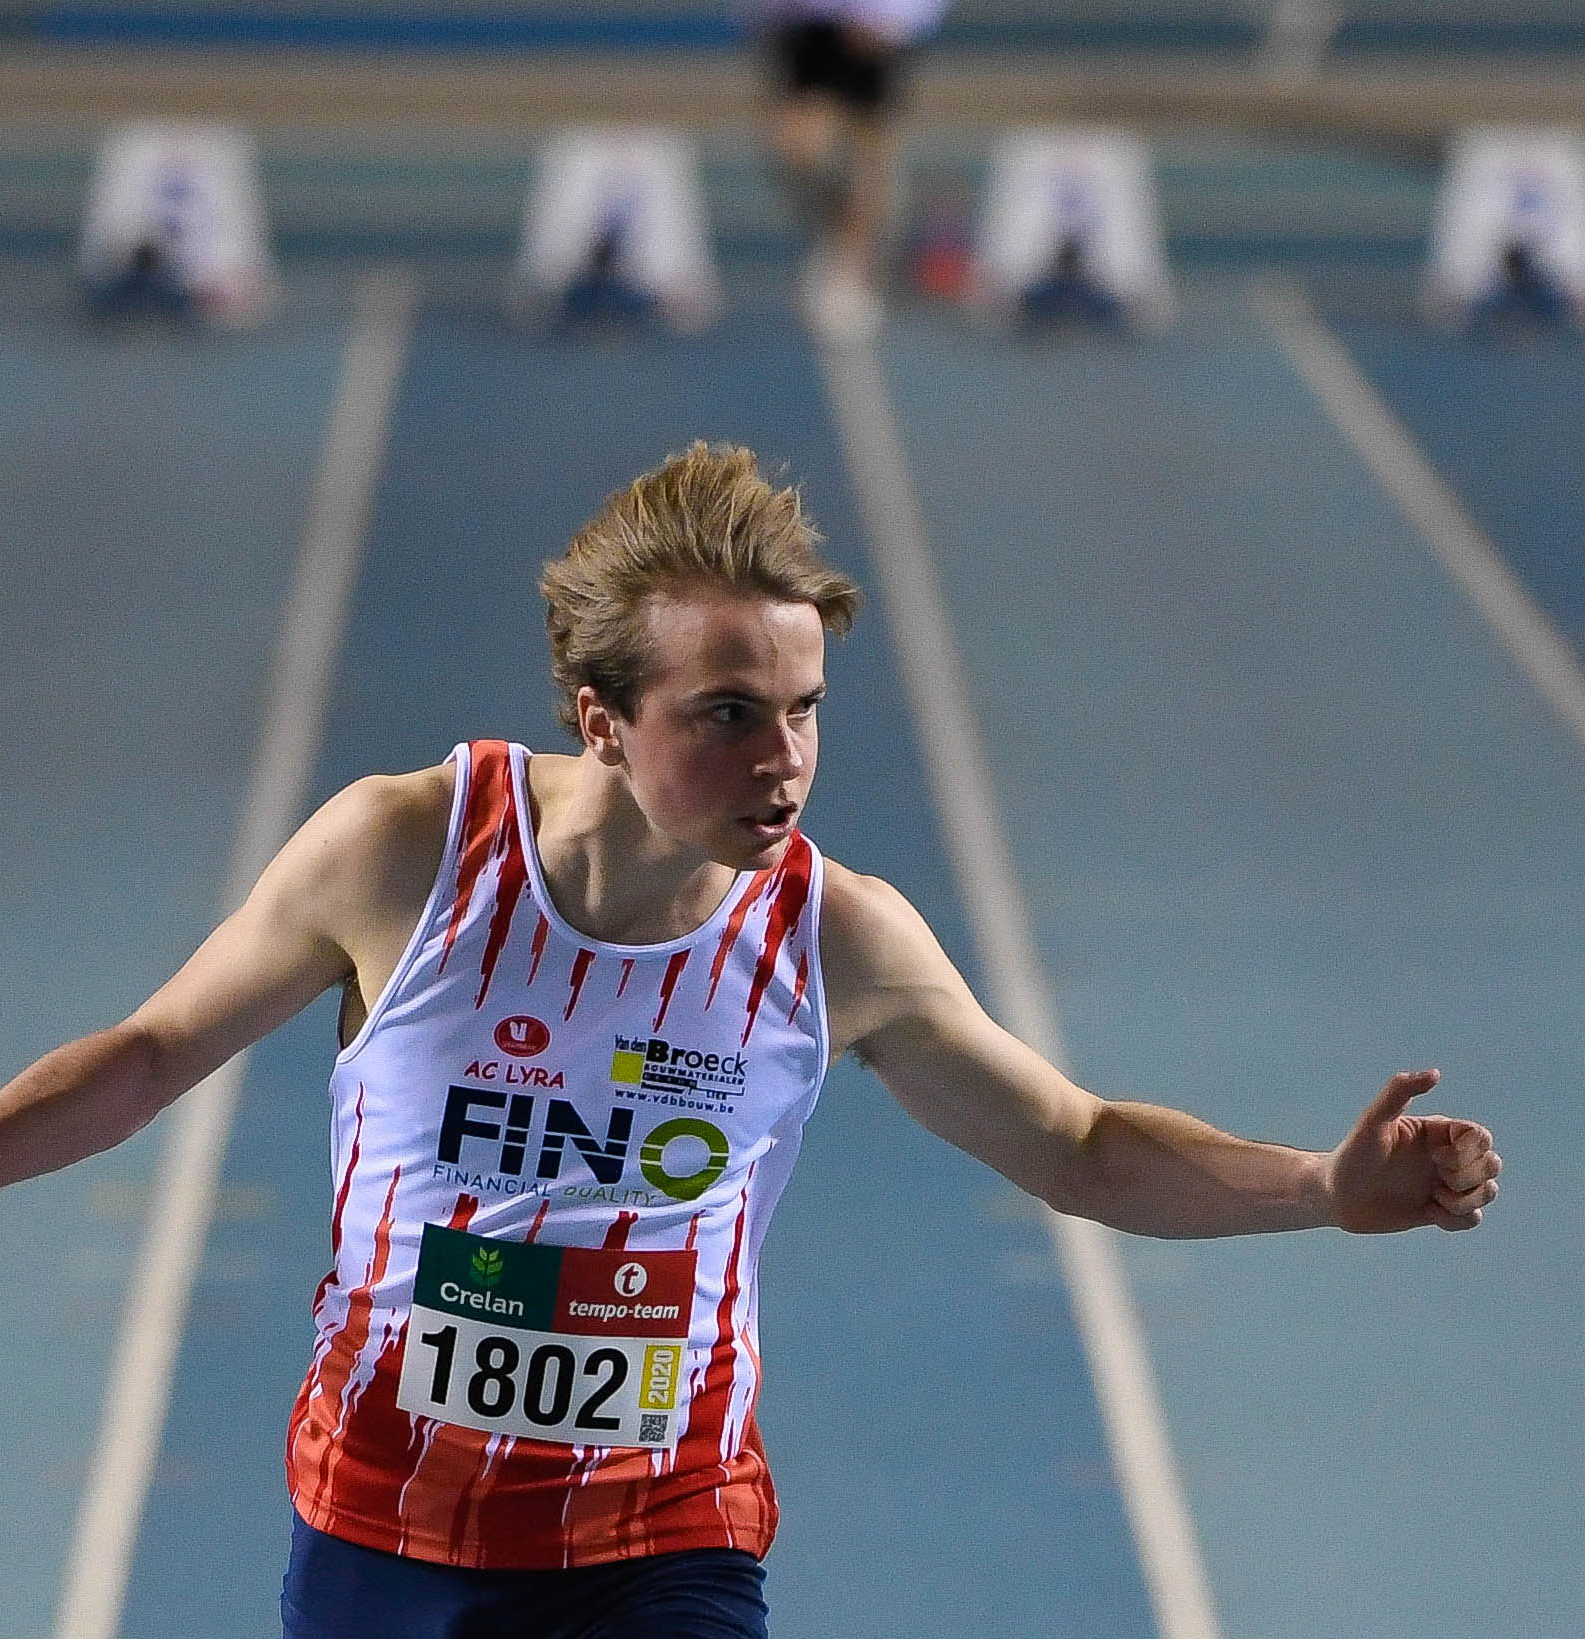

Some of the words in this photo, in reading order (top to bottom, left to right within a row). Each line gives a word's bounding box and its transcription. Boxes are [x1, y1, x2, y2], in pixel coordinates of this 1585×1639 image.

[464, 1060, 498, 1080] AC
[505, 1063, 564, 1089] LYRA
[643, 1063, 745, 1086] BOUWMATERIALEN
[646, 1038, 749, 1077] Broeck
[615, 1088, 735, 1114] www.vdbbouw.be
[436, 1085, 730, 1202] FINO
[432, 1164, 552, 1198] FINANCIAL
[439, 1281, 525, 1317] Crelan
[568, 1299, 680, 1323] tempo-team
[421, 1325, 629, 1430] 1802
[647, 1349, 674, 1404] 2020
